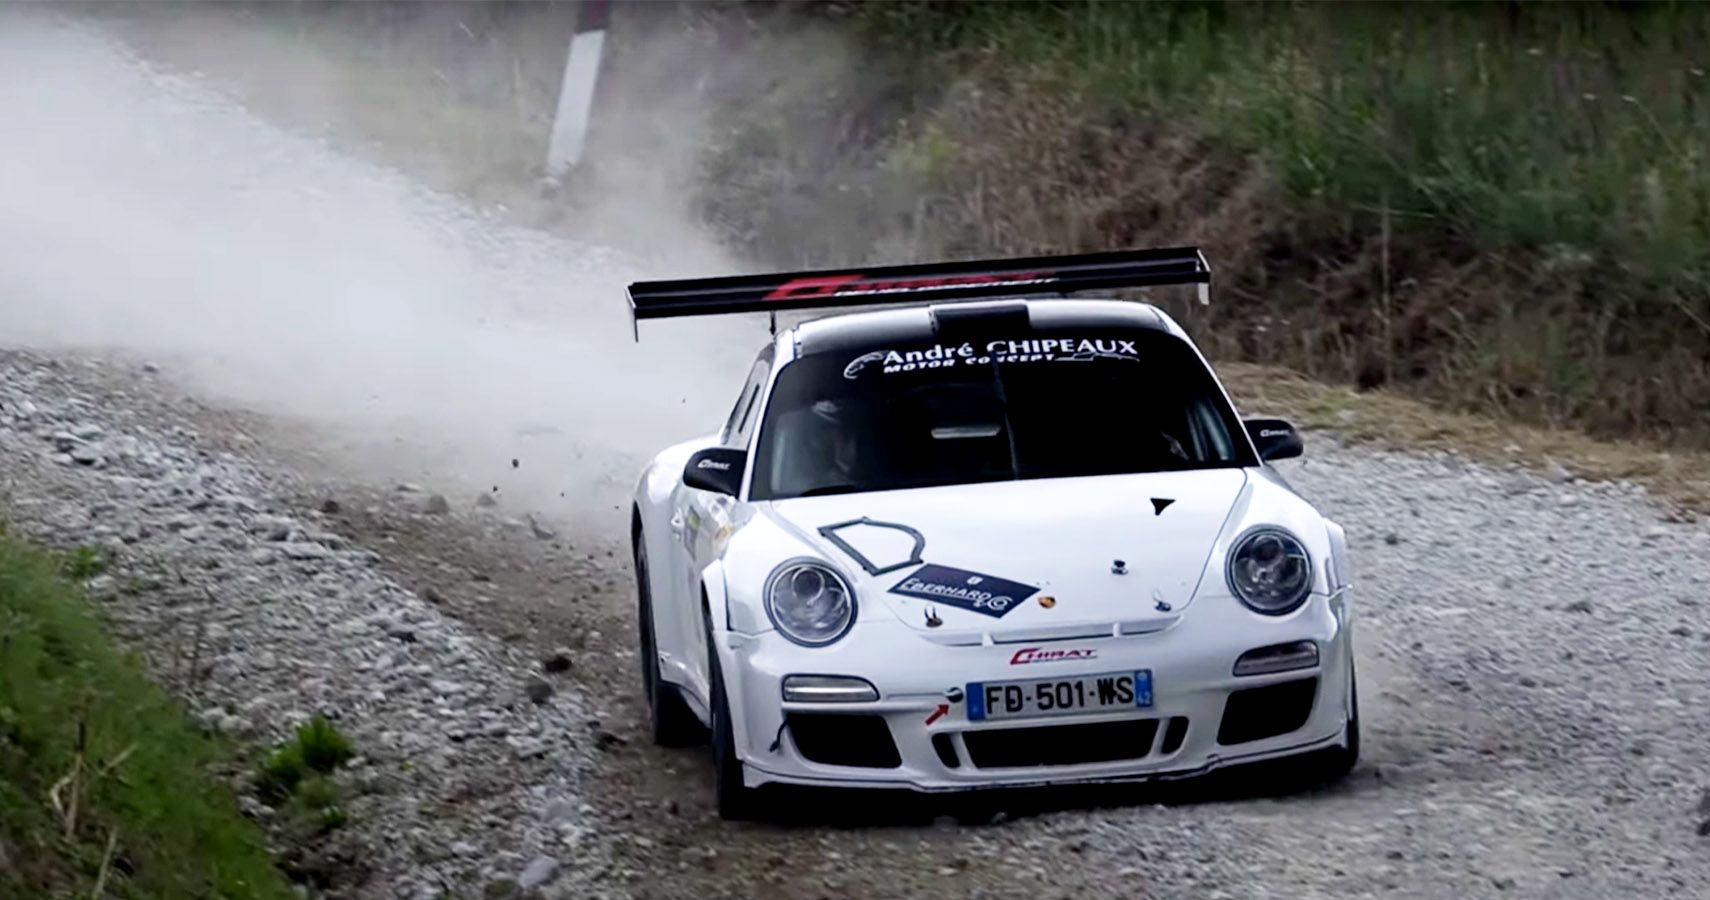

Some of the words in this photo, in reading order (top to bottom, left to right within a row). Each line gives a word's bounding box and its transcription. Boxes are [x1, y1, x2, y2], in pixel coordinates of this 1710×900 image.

[883, 342, 974, 366] André
[986, 338, 1138, 355] CHIPEAUX
[883, 359, 956, 374] MOTOR
[901, 577, 993, 601] EBERHARD
